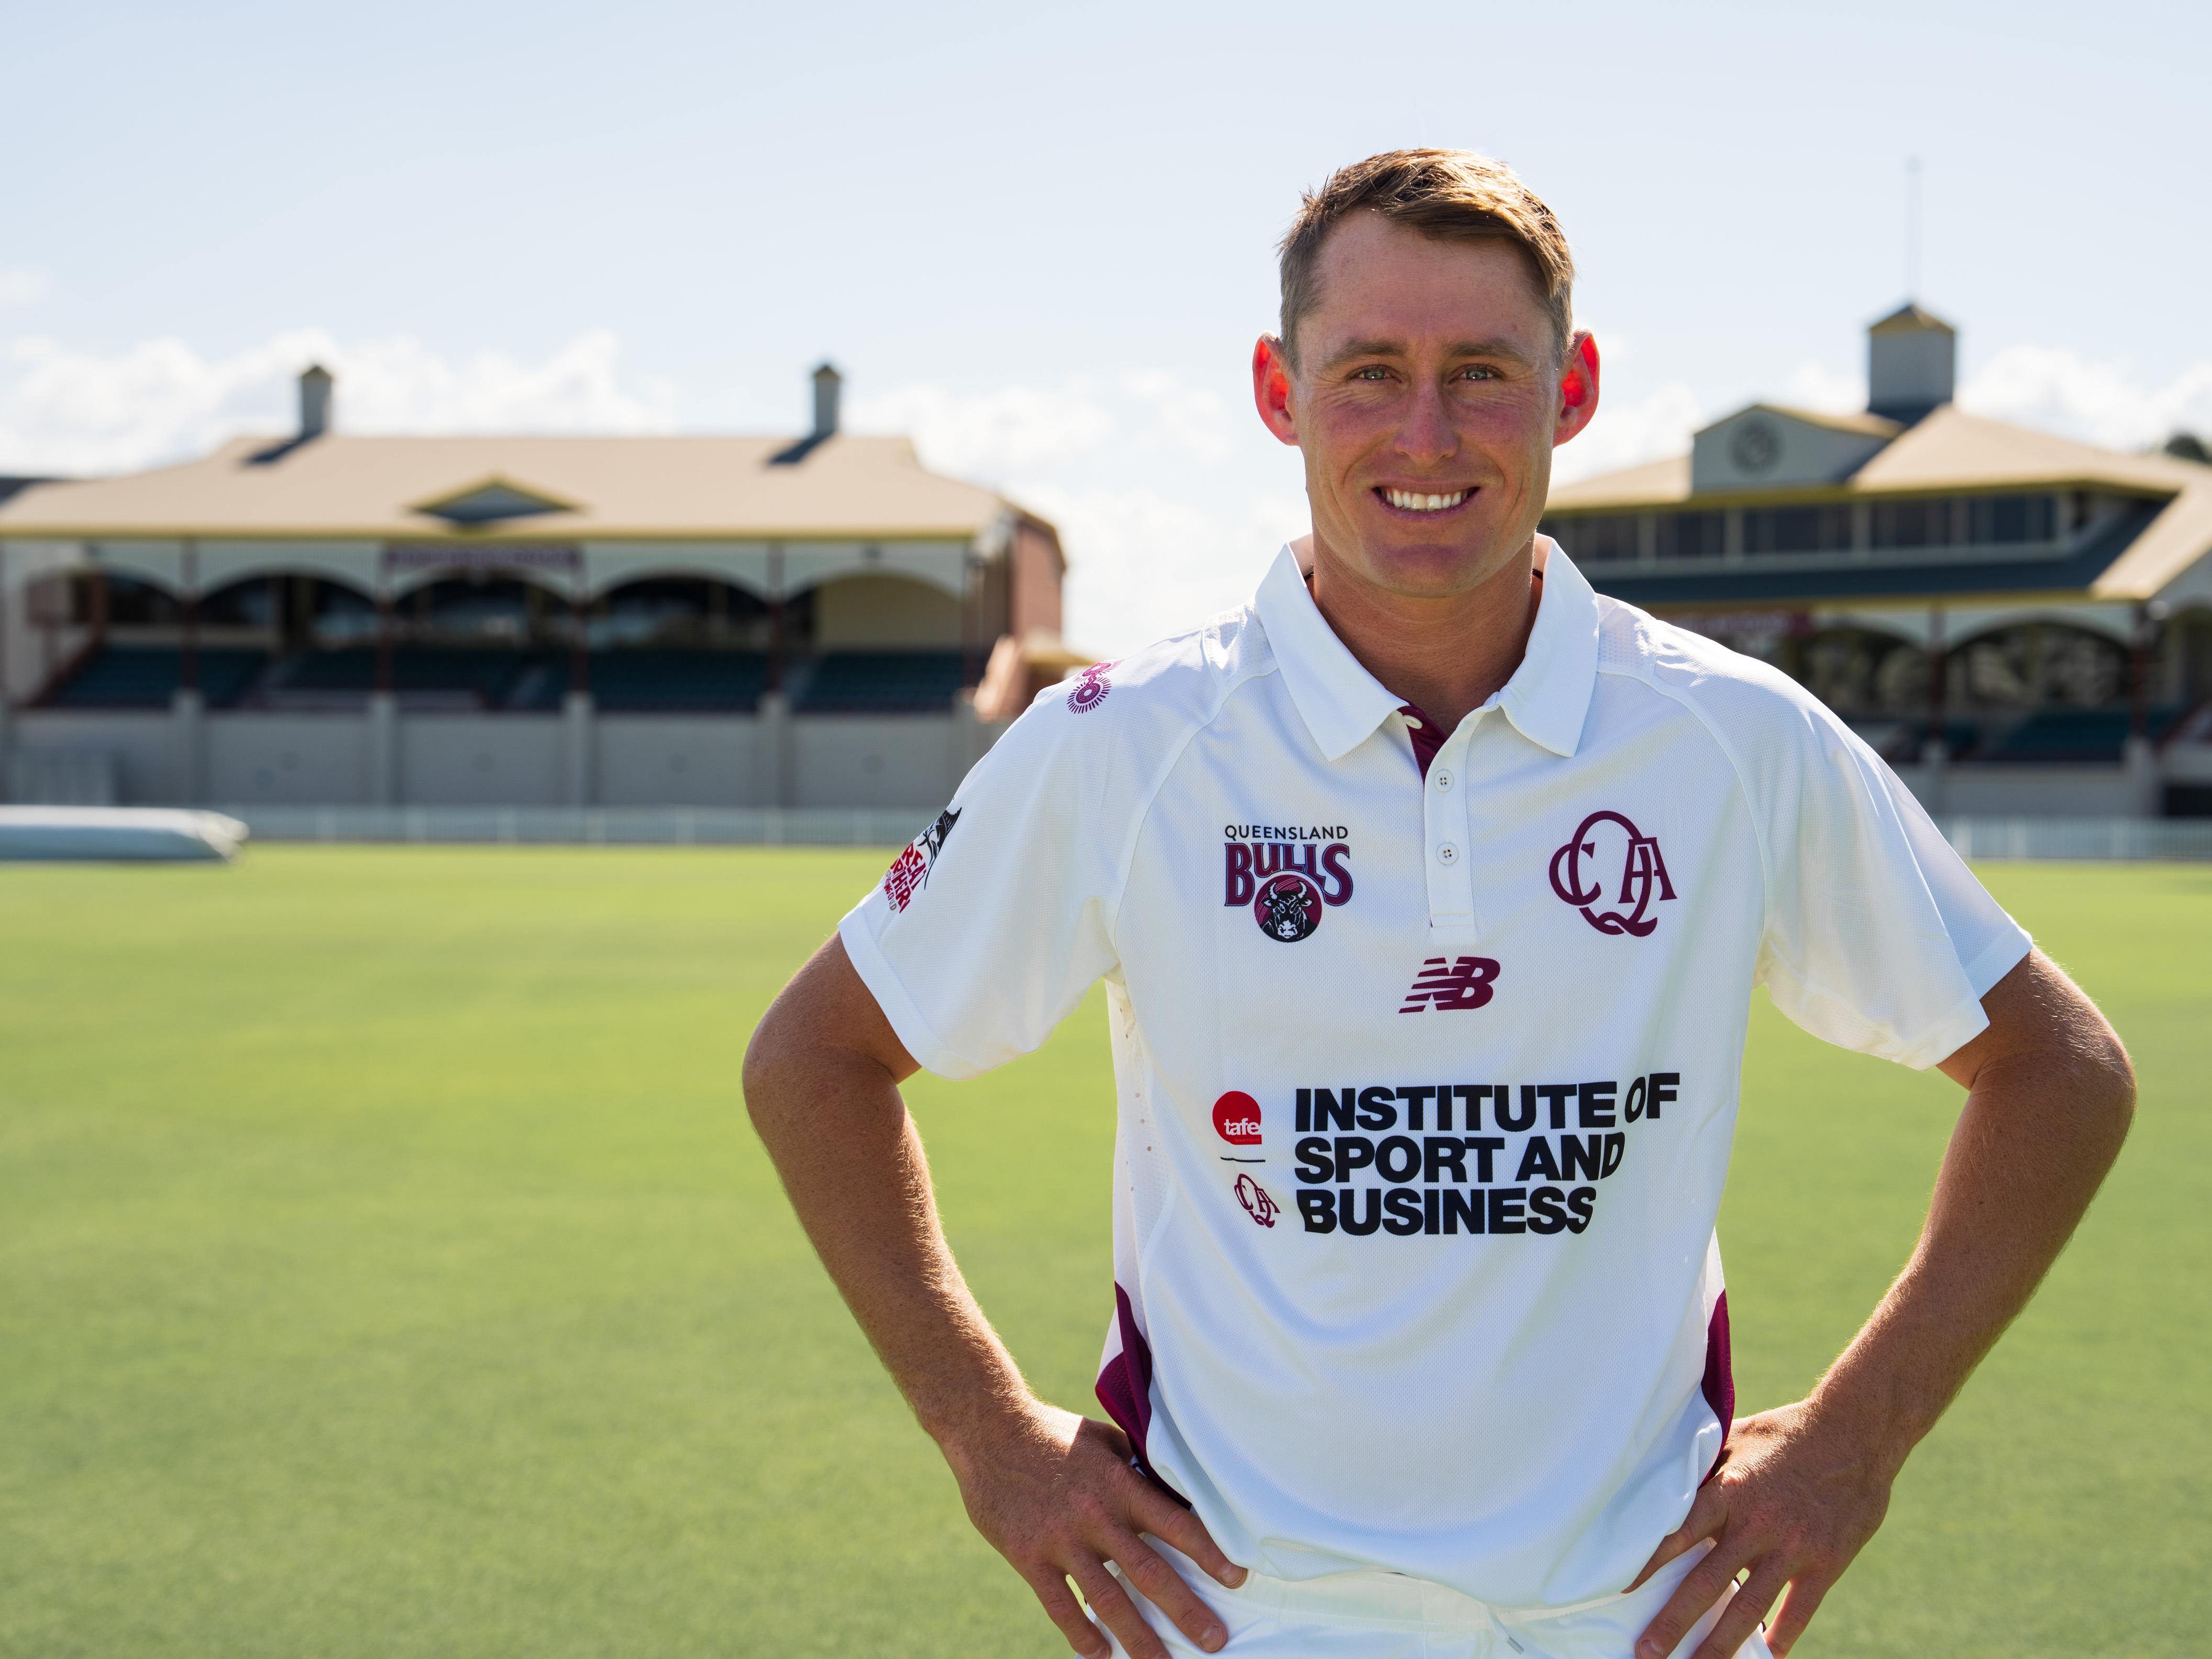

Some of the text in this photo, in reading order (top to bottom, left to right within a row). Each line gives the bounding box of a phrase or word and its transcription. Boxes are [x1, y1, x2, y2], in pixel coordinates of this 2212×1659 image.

[1224, 825, 1348, 841] QUEENSLAND
[901, 841, 926, 891] REAT
[1224, 843, 1353, 906] BULLS
[1224, 1118, 1260, 1136] tafe
[1295, 1072, 1680, 1132] INSTITUTE OF
[1294, 1132, 1625, 1184] SPORT AND
[1296, 1186, 1597, 1236] BUSINESS
